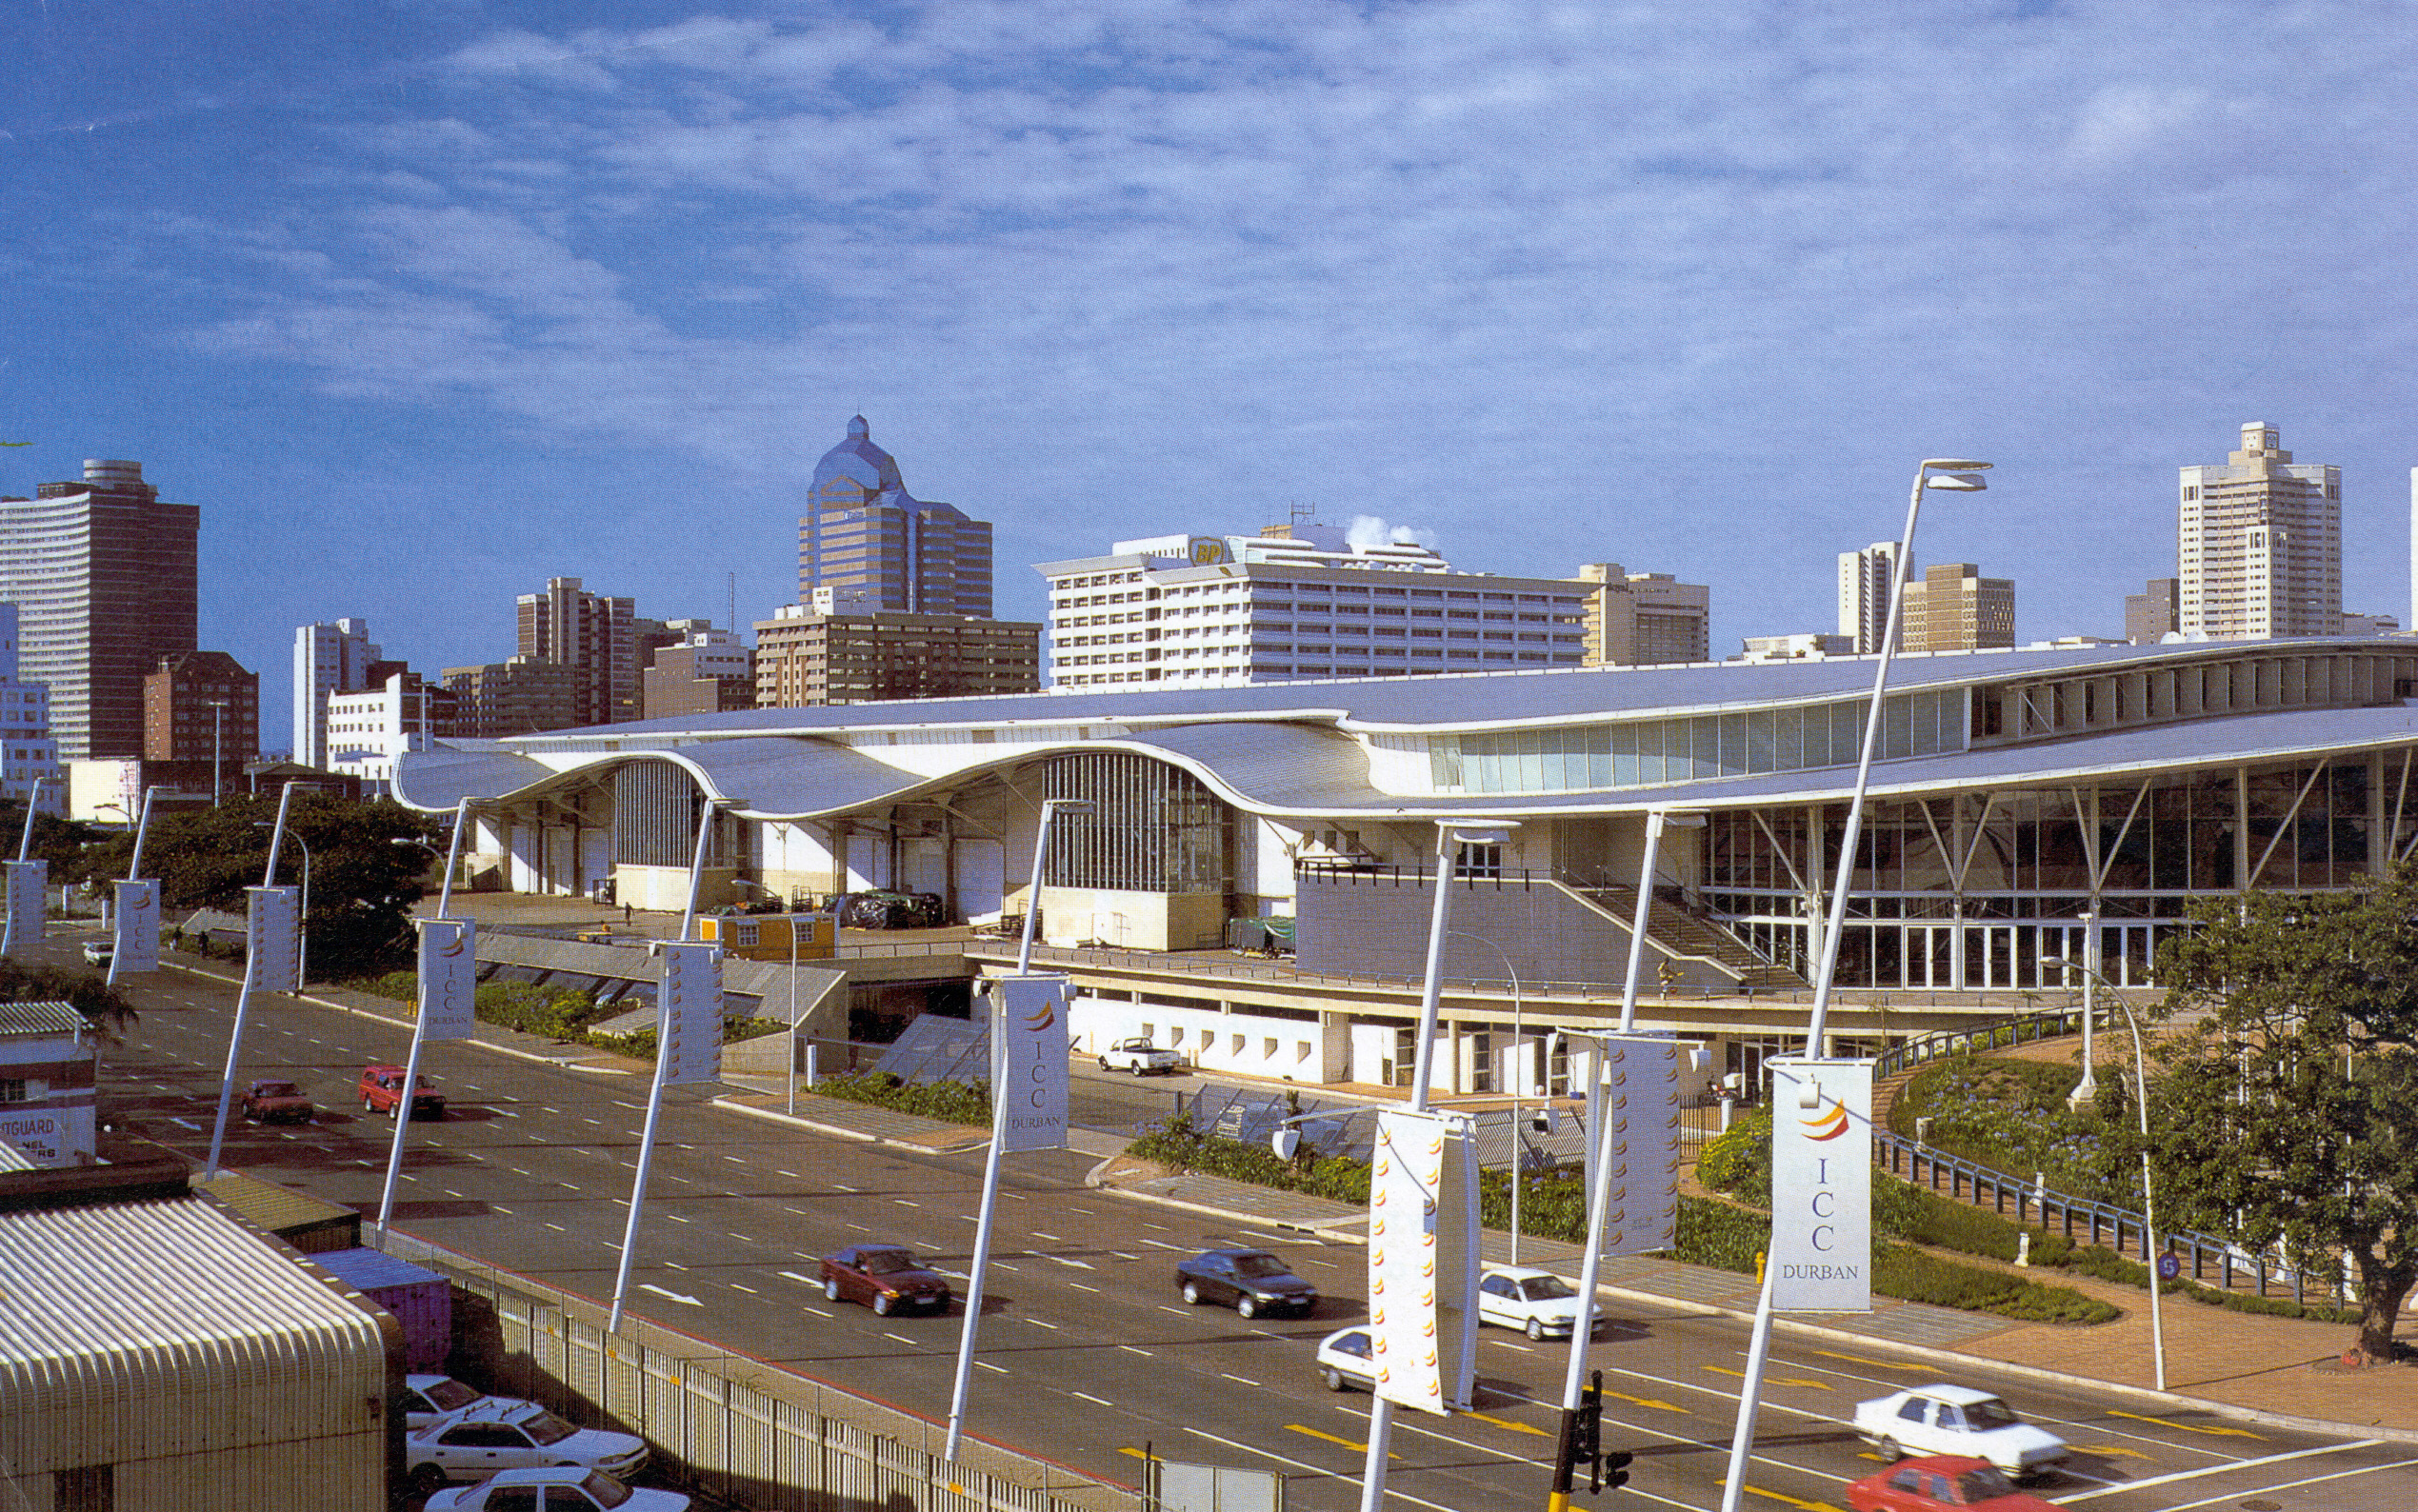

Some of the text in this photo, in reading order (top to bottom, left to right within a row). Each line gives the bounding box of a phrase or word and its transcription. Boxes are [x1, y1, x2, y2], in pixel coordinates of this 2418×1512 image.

[1196, 544, 1221, 564] BP
[1011, 1116, 1061, 1130] DURBAN
[1783, 1263, 1858, 1282] DURBAN
